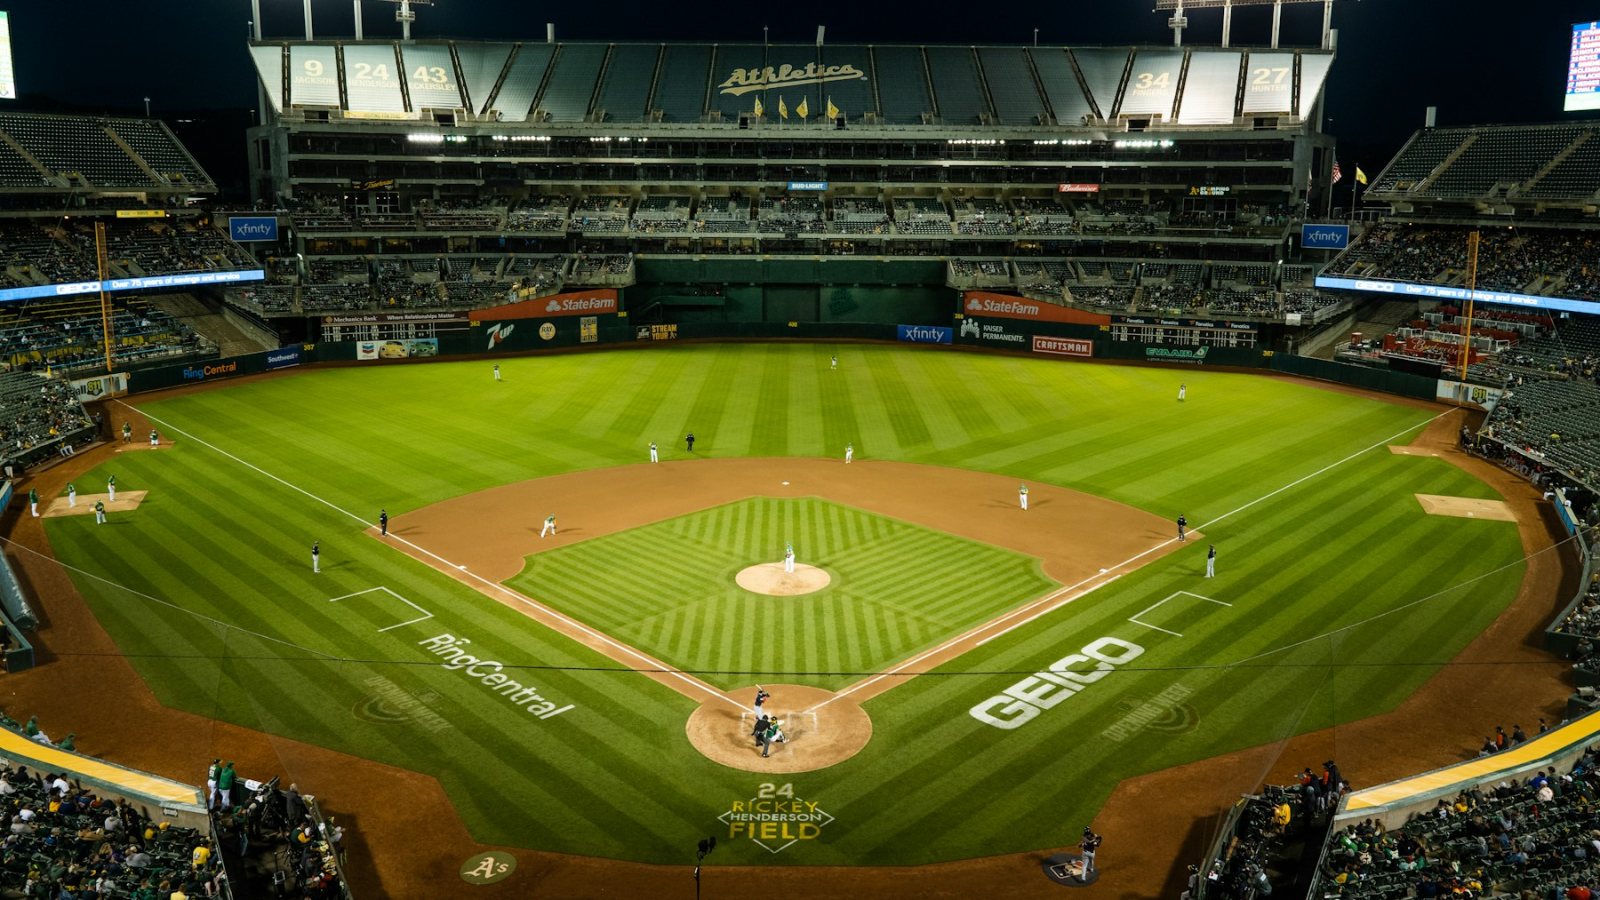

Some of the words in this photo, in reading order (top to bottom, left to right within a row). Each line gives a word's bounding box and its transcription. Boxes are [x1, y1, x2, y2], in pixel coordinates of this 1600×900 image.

[303, 59, 324, 77] 9
[354, 62, 389, 80] 24
[413, 66, 448, 83] 43
[1252, 67, 1290, 85] 27
[718, 62, 864, 96] Athletics
[1135, 71, 1171, 90] 34
[237, 223, 271, 236] xfinity
[1308, 231, 1342, 243] xfinity
[112, 280, 128, 289] Over
[143, 278, 163, 288] years
[1406, 284, 1422, 293] Over
[1437, 288, 1456, 298] years
[905, 327, 944, 342] xfinity
[983, 325, 1003, 333] KAISER
[183, 361, 236, 379] RingCentral
[87, 379, 102, 391] 811
[1473, 387, 1487, 399] 811
[418, 633, 576, 720] RingCentral
[969, 637, 1145, 730] GEICO
[1103, 698, 1158, 742] OPENING
[1153, 682, 1194, 708] WEEK
[757, 783, 794, 799] 24
[732, 800, 818, 813] RICKEY
[730, 813, 822, 822] HENDERSON
[729, 822, 821, 839] FIELD
[463, 856, 509, 879] A's
